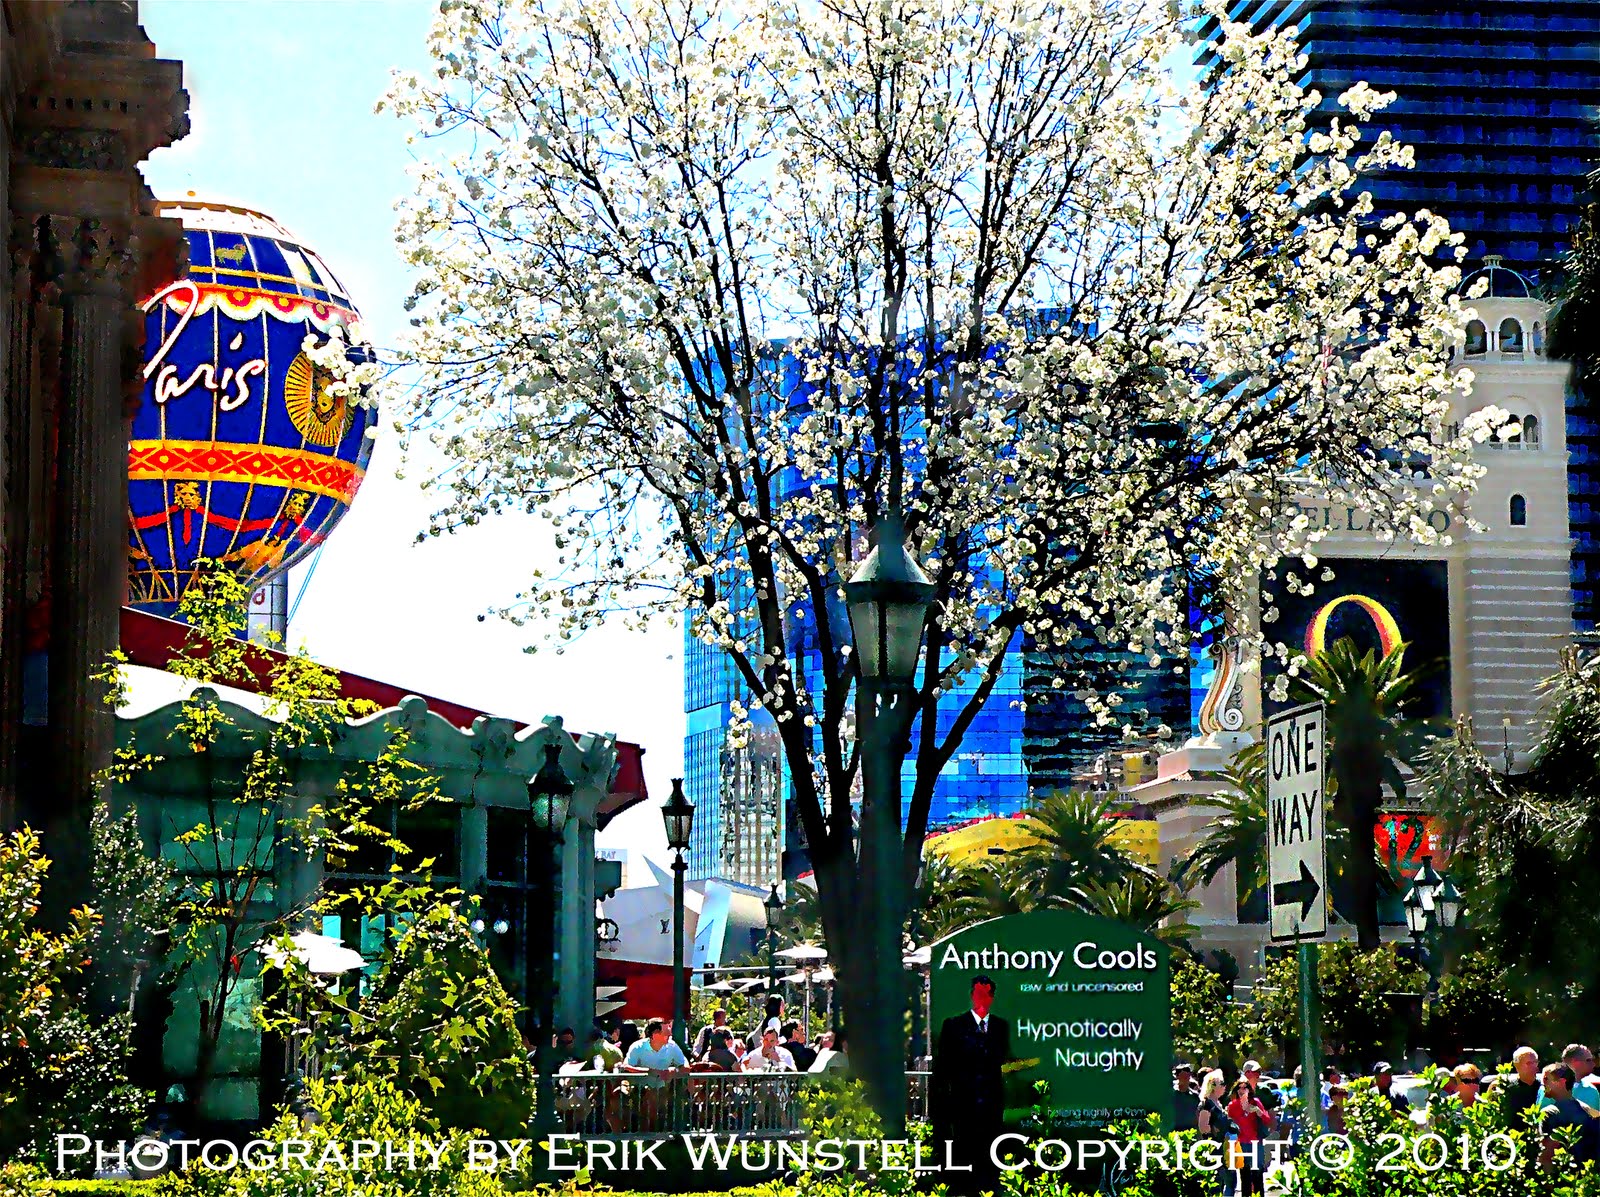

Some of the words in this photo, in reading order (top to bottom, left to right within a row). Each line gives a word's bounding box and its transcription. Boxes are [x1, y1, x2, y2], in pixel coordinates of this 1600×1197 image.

[142, 279, 266, 412] Paris
[1272, 721, 1317, 781] ONE
[1272, 790, 1318, 847] WAY
[939, 942, 1064, 977] Anthony
[1073, 942, 1157, 970] Cools
[1020, 982, 1042, 992] raw
[1045, 981, 1069, 992] and
[1071, 981, 1144, 992] uncensored
[1017, 1018, 1143, 1042] Hypnotically
[1055, 1047, 1144, 1072] Naughty
